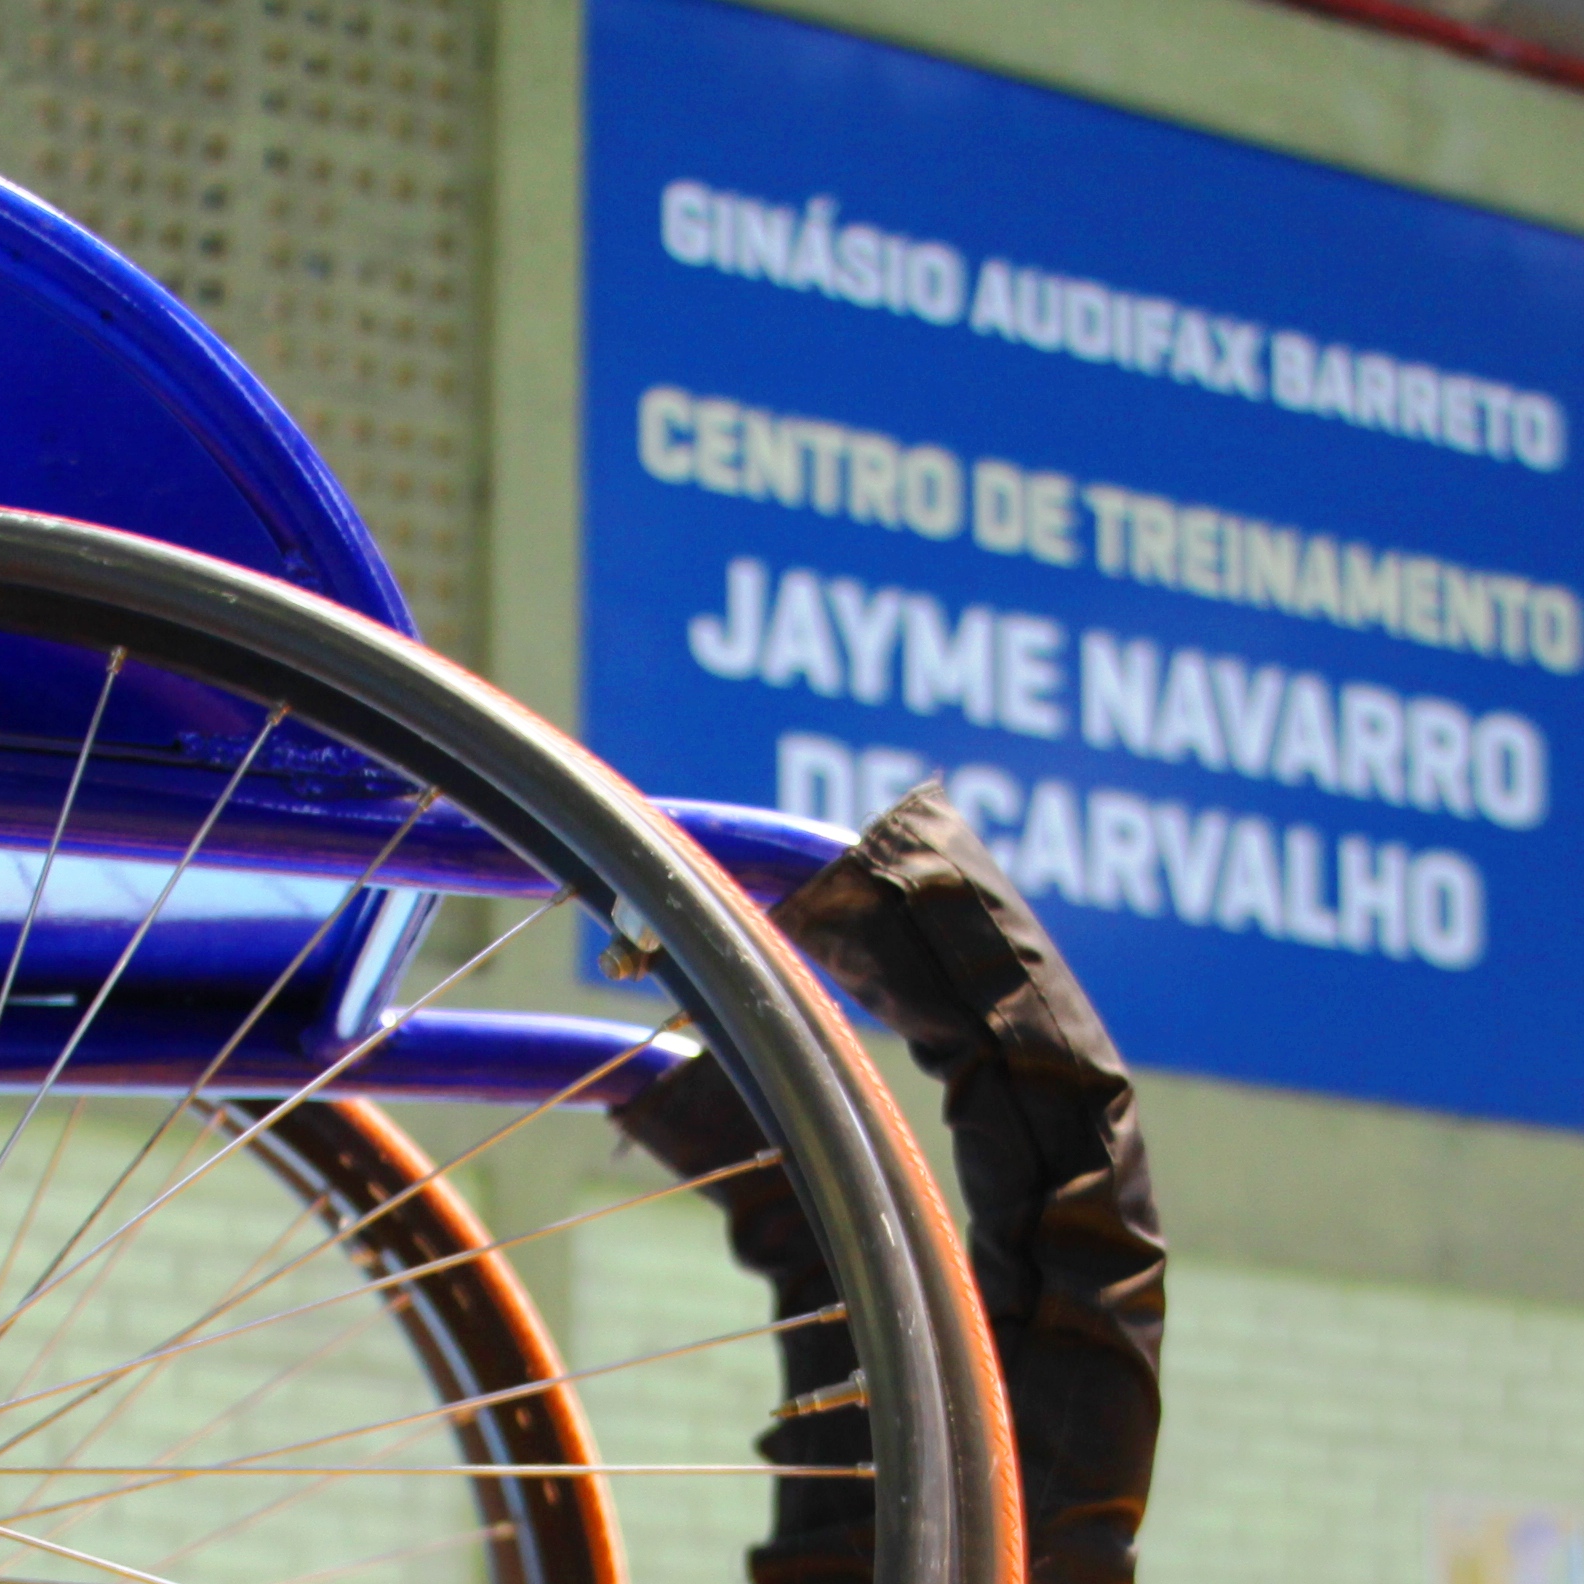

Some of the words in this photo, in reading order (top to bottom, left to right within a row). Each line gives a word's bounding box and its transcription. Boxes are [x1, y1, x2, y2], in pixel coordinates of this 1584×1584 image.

[661, 180, 966, 326] GINÁSIO
[970, 260, 1263, 401] AUDIFAX
[1272, 333, 1566, 471] BARRETO
[639, 387, 962, 540] CENTRO
[975, 460, 1081, 566] DE
[689, 558, 1066, 740] JAYME
[1080, 630, 1547, 830] NAVARRO
[946, 764, 1484, 972] CARVALHO
